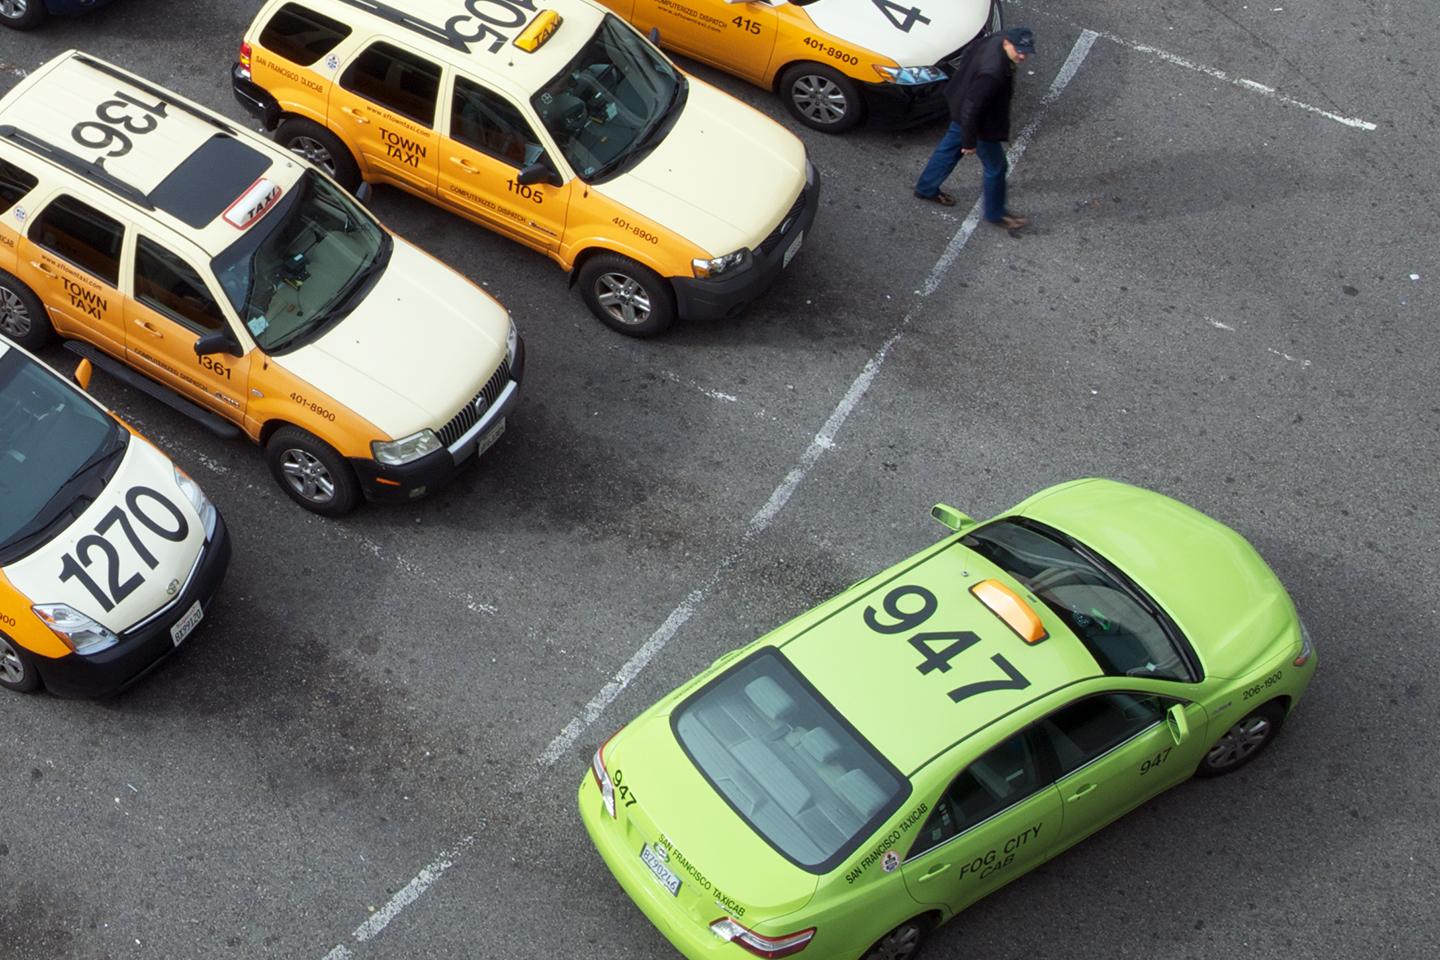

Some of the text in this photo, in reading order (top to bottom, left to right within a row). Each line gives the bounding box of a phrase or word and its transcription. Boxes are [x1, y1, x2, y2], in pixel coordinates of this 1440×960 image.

[445, 0, 538, 54] 05
[534, 14, 561, 48] TAXI
[732, 15, 762, 35] 415
[803, 36, 859, 66] 401-8900
[256, 55, 324, 95] SAN FRANCISCO TAXICAB
[366, 105, 431, 138] www.sftowntaxi.com
[379, 127, 427, 158] TOWN
[385, 143, 420, 168] TAXI
[247, 187, 276, 219] TAXI
[506, 179, 544, 204] 1105
[612, 216, 659, 245] 401-8900
[61, 276, 108, 312] TOWN
[68, 293, 102, 320] TAXI
[198, 354, 232, 380] 1361
[289, 391, 336, 423] 401-8900
[58, 485, 189, 614] 1270
[863, 584, 1032, 704] 947
[1242, 670, 1282, 700] 206-1900
[1139, 746, 1173, 776] 947
[612, 769, 637, 808] 947
[845, 802, 929, 885] SAN FRANCISCO TAXICAB
[959, 822, 1043, 881] FOG CITY
[658, 833, 746, 917] SAN FRANCISCO TAXICAB
[979, 852, 1016, 880] CAB
